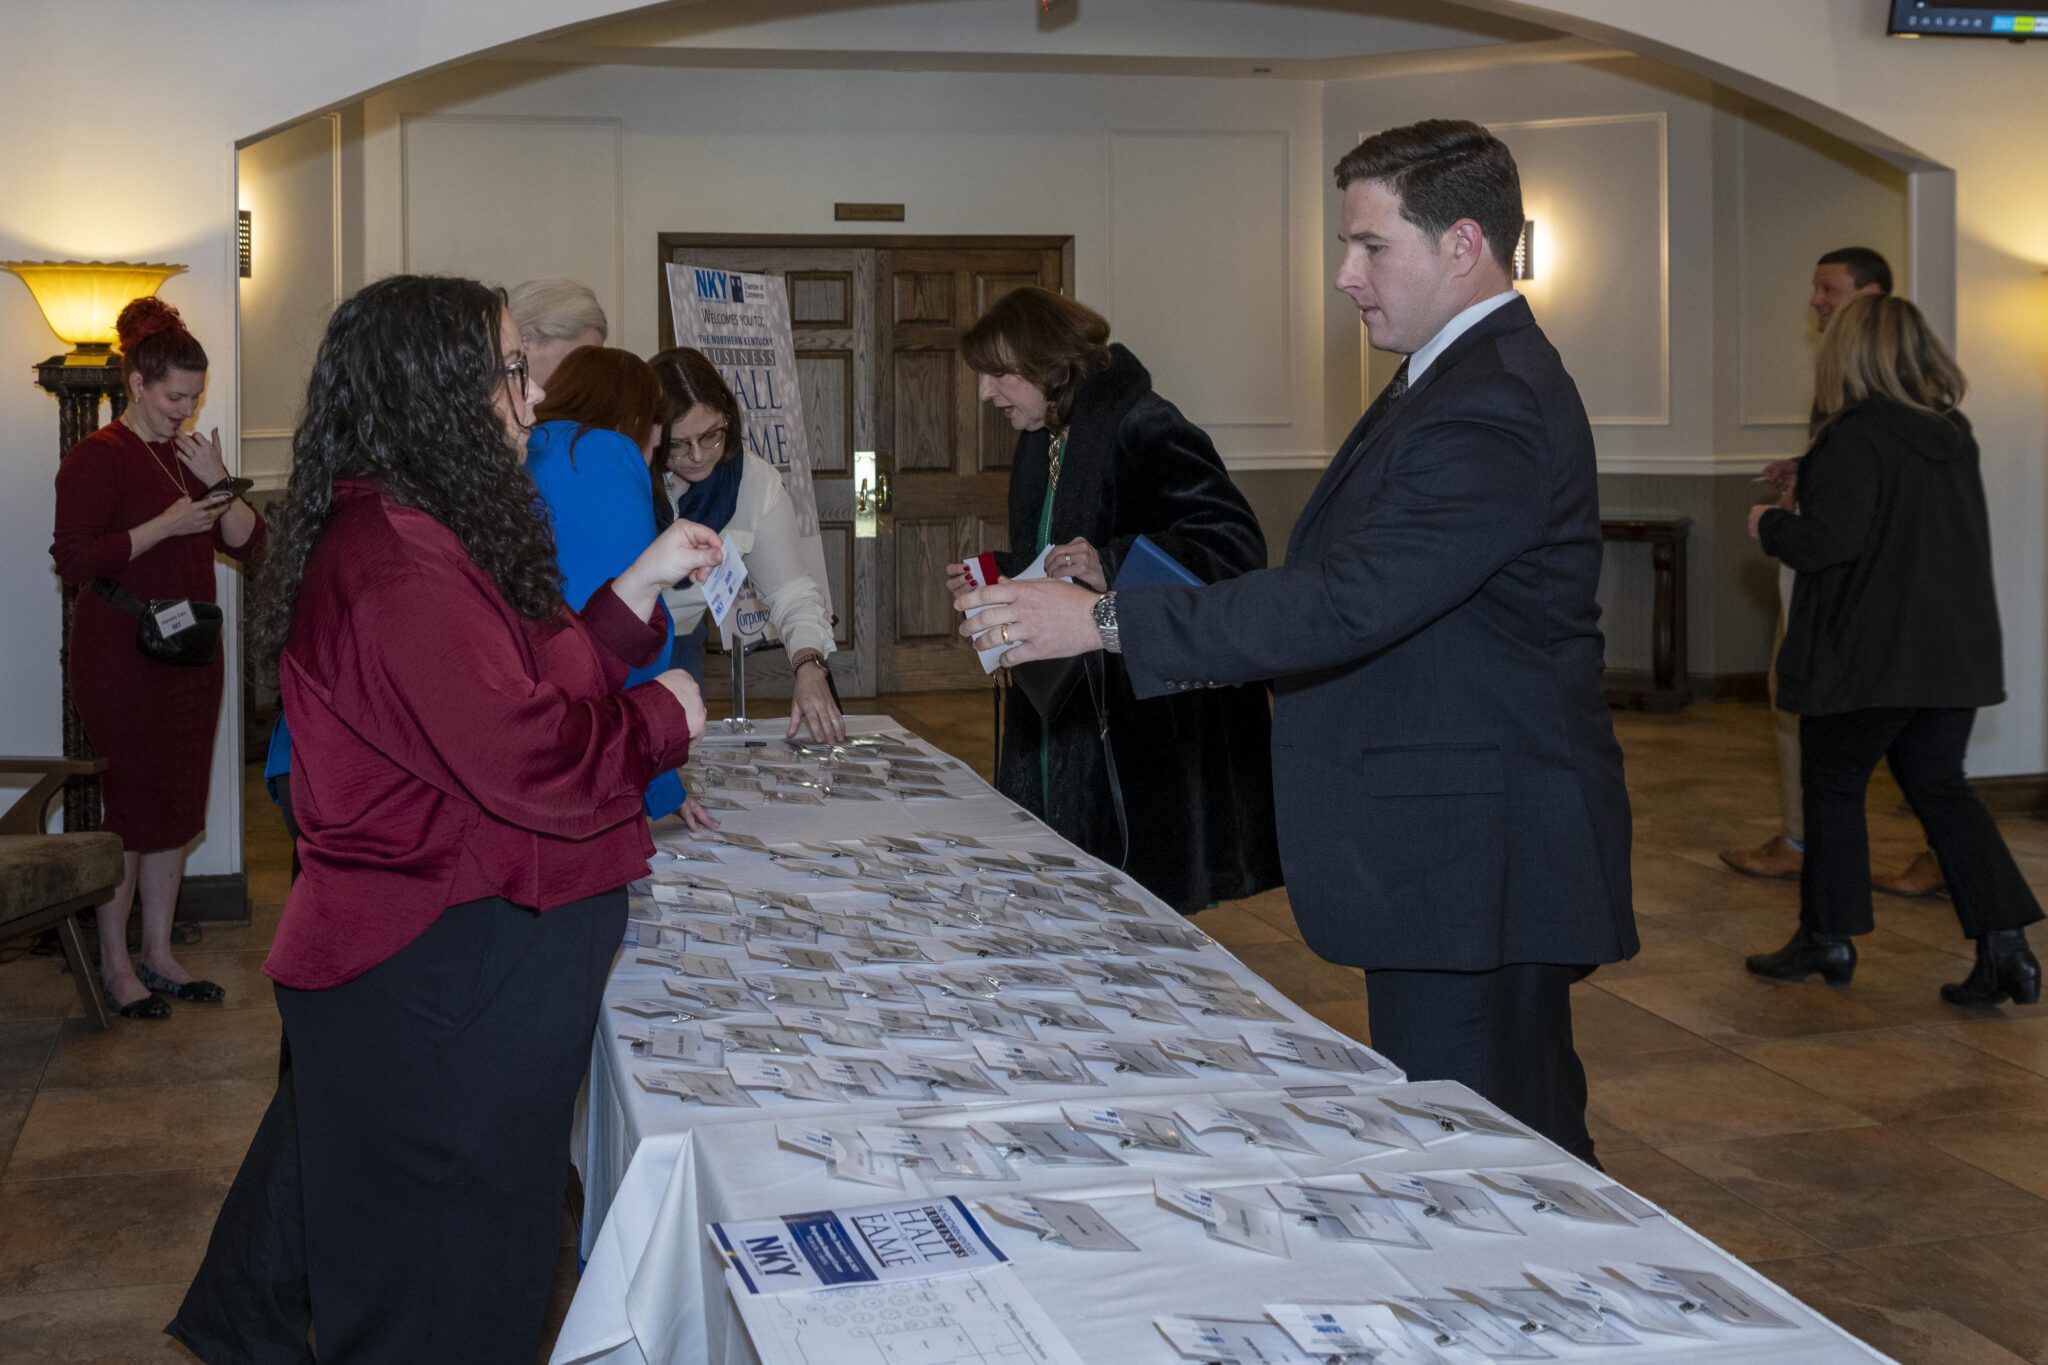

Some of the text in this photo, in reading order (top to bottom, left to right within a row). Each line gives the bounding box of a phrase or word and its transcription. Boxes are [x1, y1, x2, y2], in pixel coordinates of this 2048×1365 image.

[695, 269, 727, 299] NKY
[699, 335, 773, 346] THE NORTHERN KENTUCKY
[703, 349, 775, 364] BUSINESS
[719, 369, 782, 409] ALL
[857, 1213, 916, 1267] FAME
[894, 1208, 951, 1262] HALL
[923, 1207, 967, 1257] BUSINESS
[745, 1235, 802, 1276] NKY
